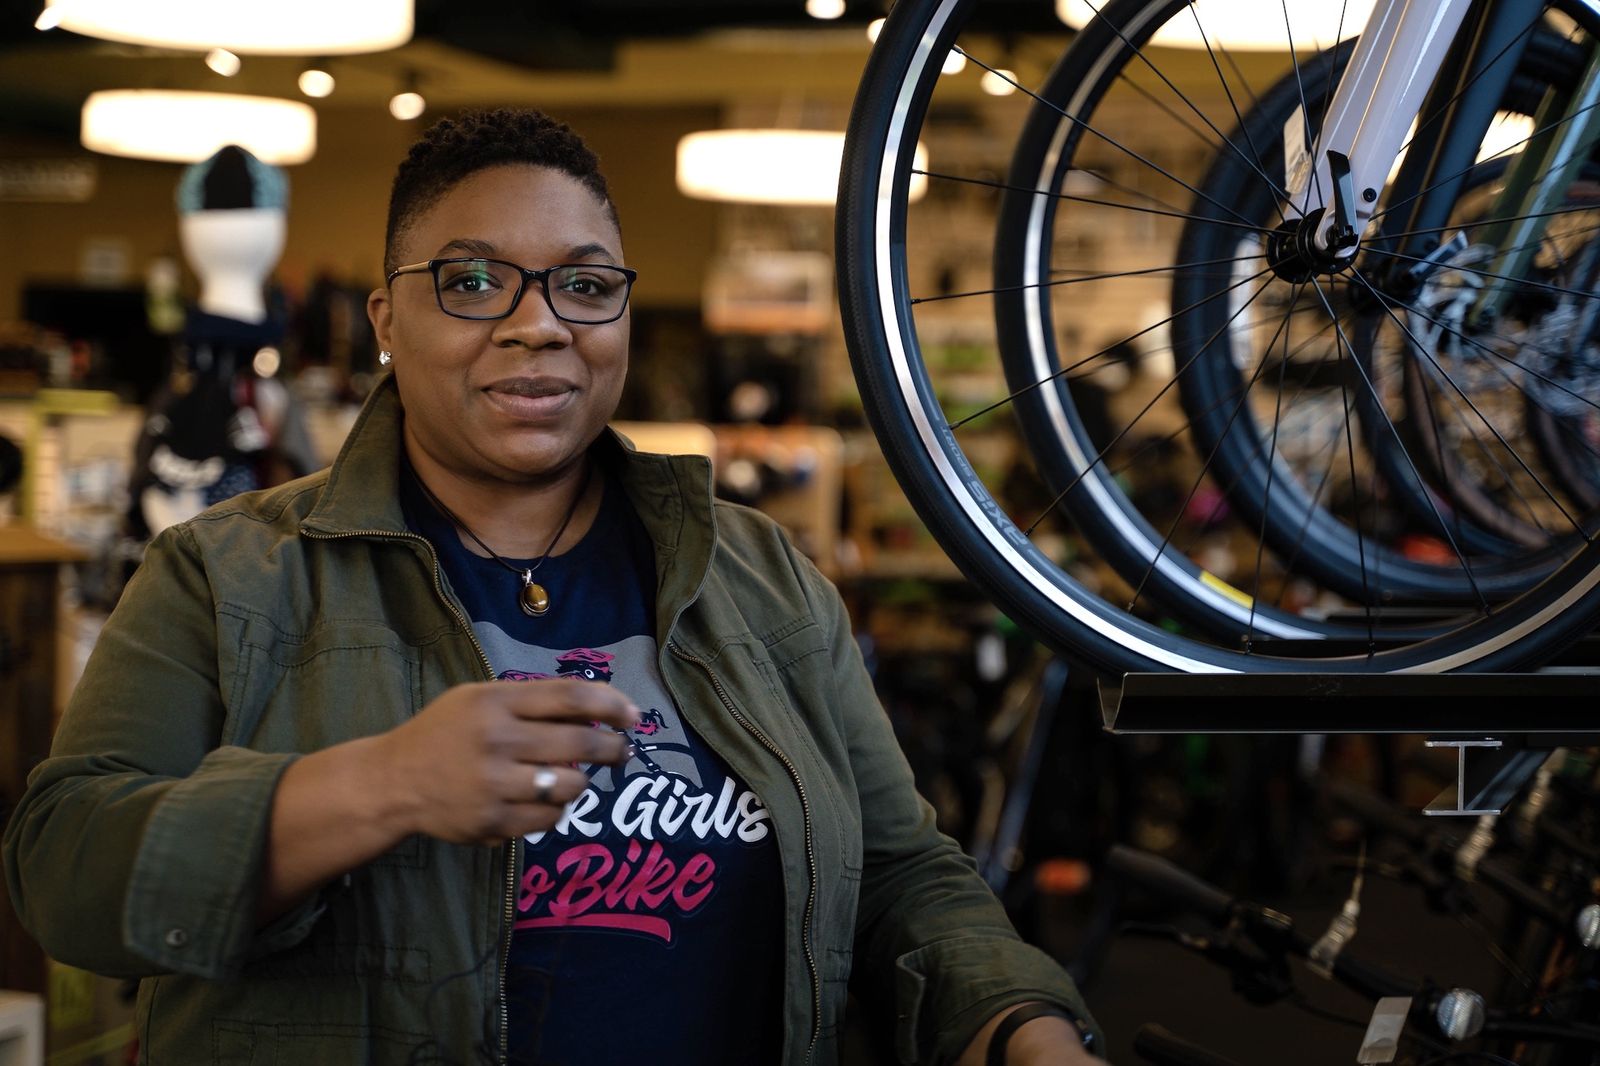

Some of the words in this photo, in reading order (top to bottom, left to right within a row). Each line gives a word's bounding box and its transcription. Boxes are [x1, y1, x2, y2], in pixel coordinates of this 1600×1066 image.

[942, 427, 972, 479] SPORT
[611, 775, 770, 842] Girls
[549, 838, 716, 917] Bike
